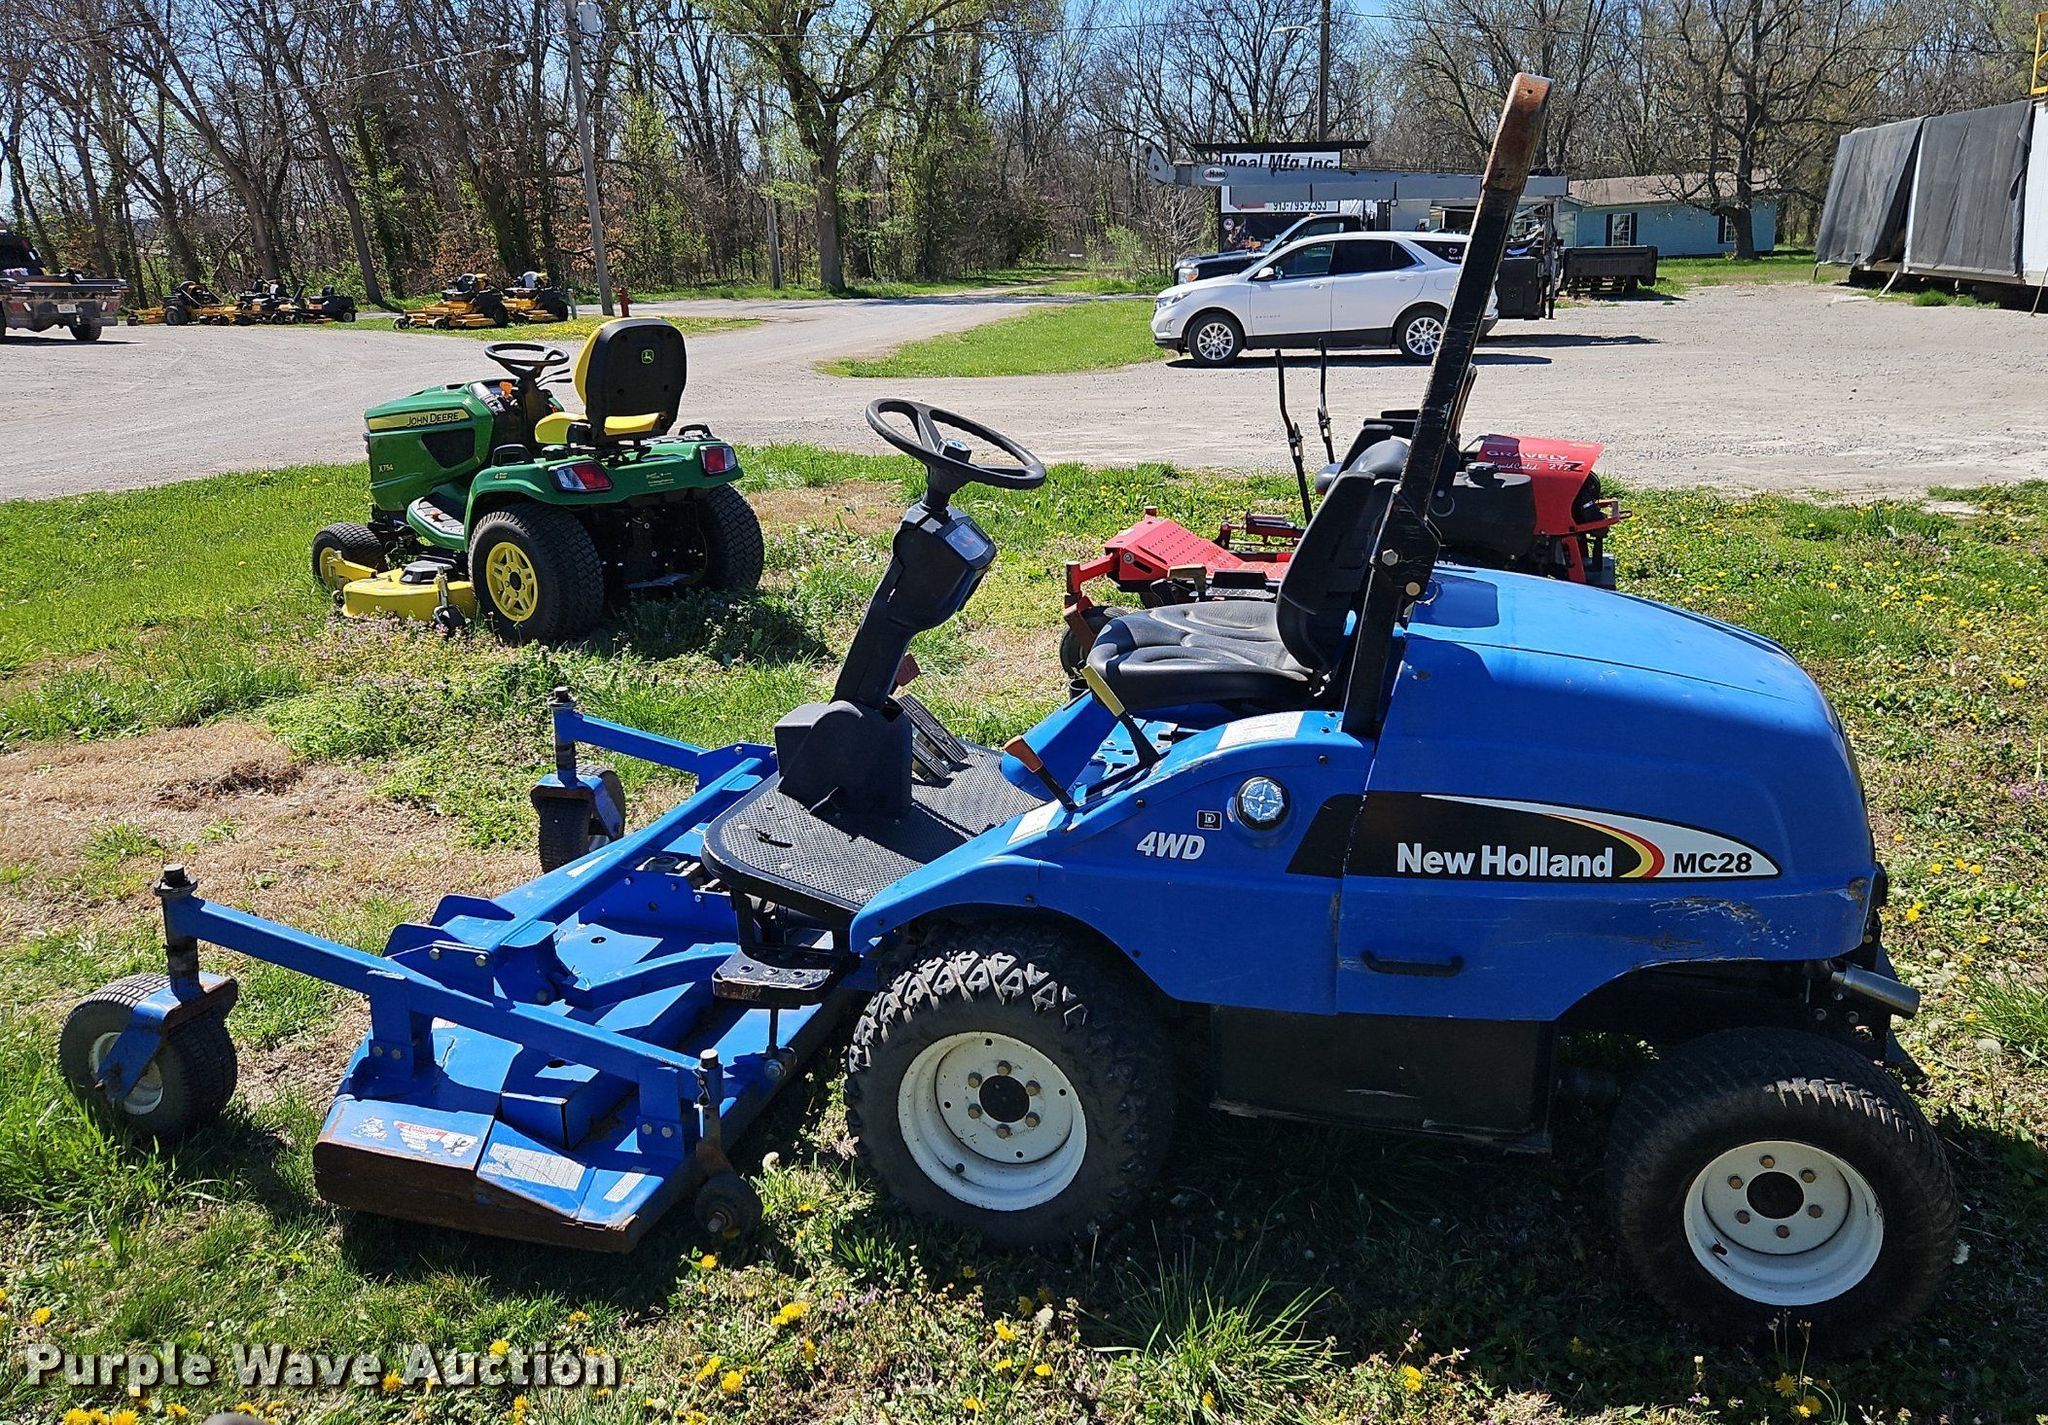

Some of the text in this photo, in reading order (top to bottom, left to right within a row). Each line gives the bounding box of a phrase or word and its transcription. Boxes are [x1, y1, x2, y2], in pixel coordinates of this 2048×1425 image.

[407, 412, 460, 426] JOHN DEERE
[1487, 450, 1569, 461] GRAVELY
[1136, 831, 1206, 860] 4WD
[1396, 842, 1613, 879] New Holland
[1673, 853, 1753, 874] MC28
